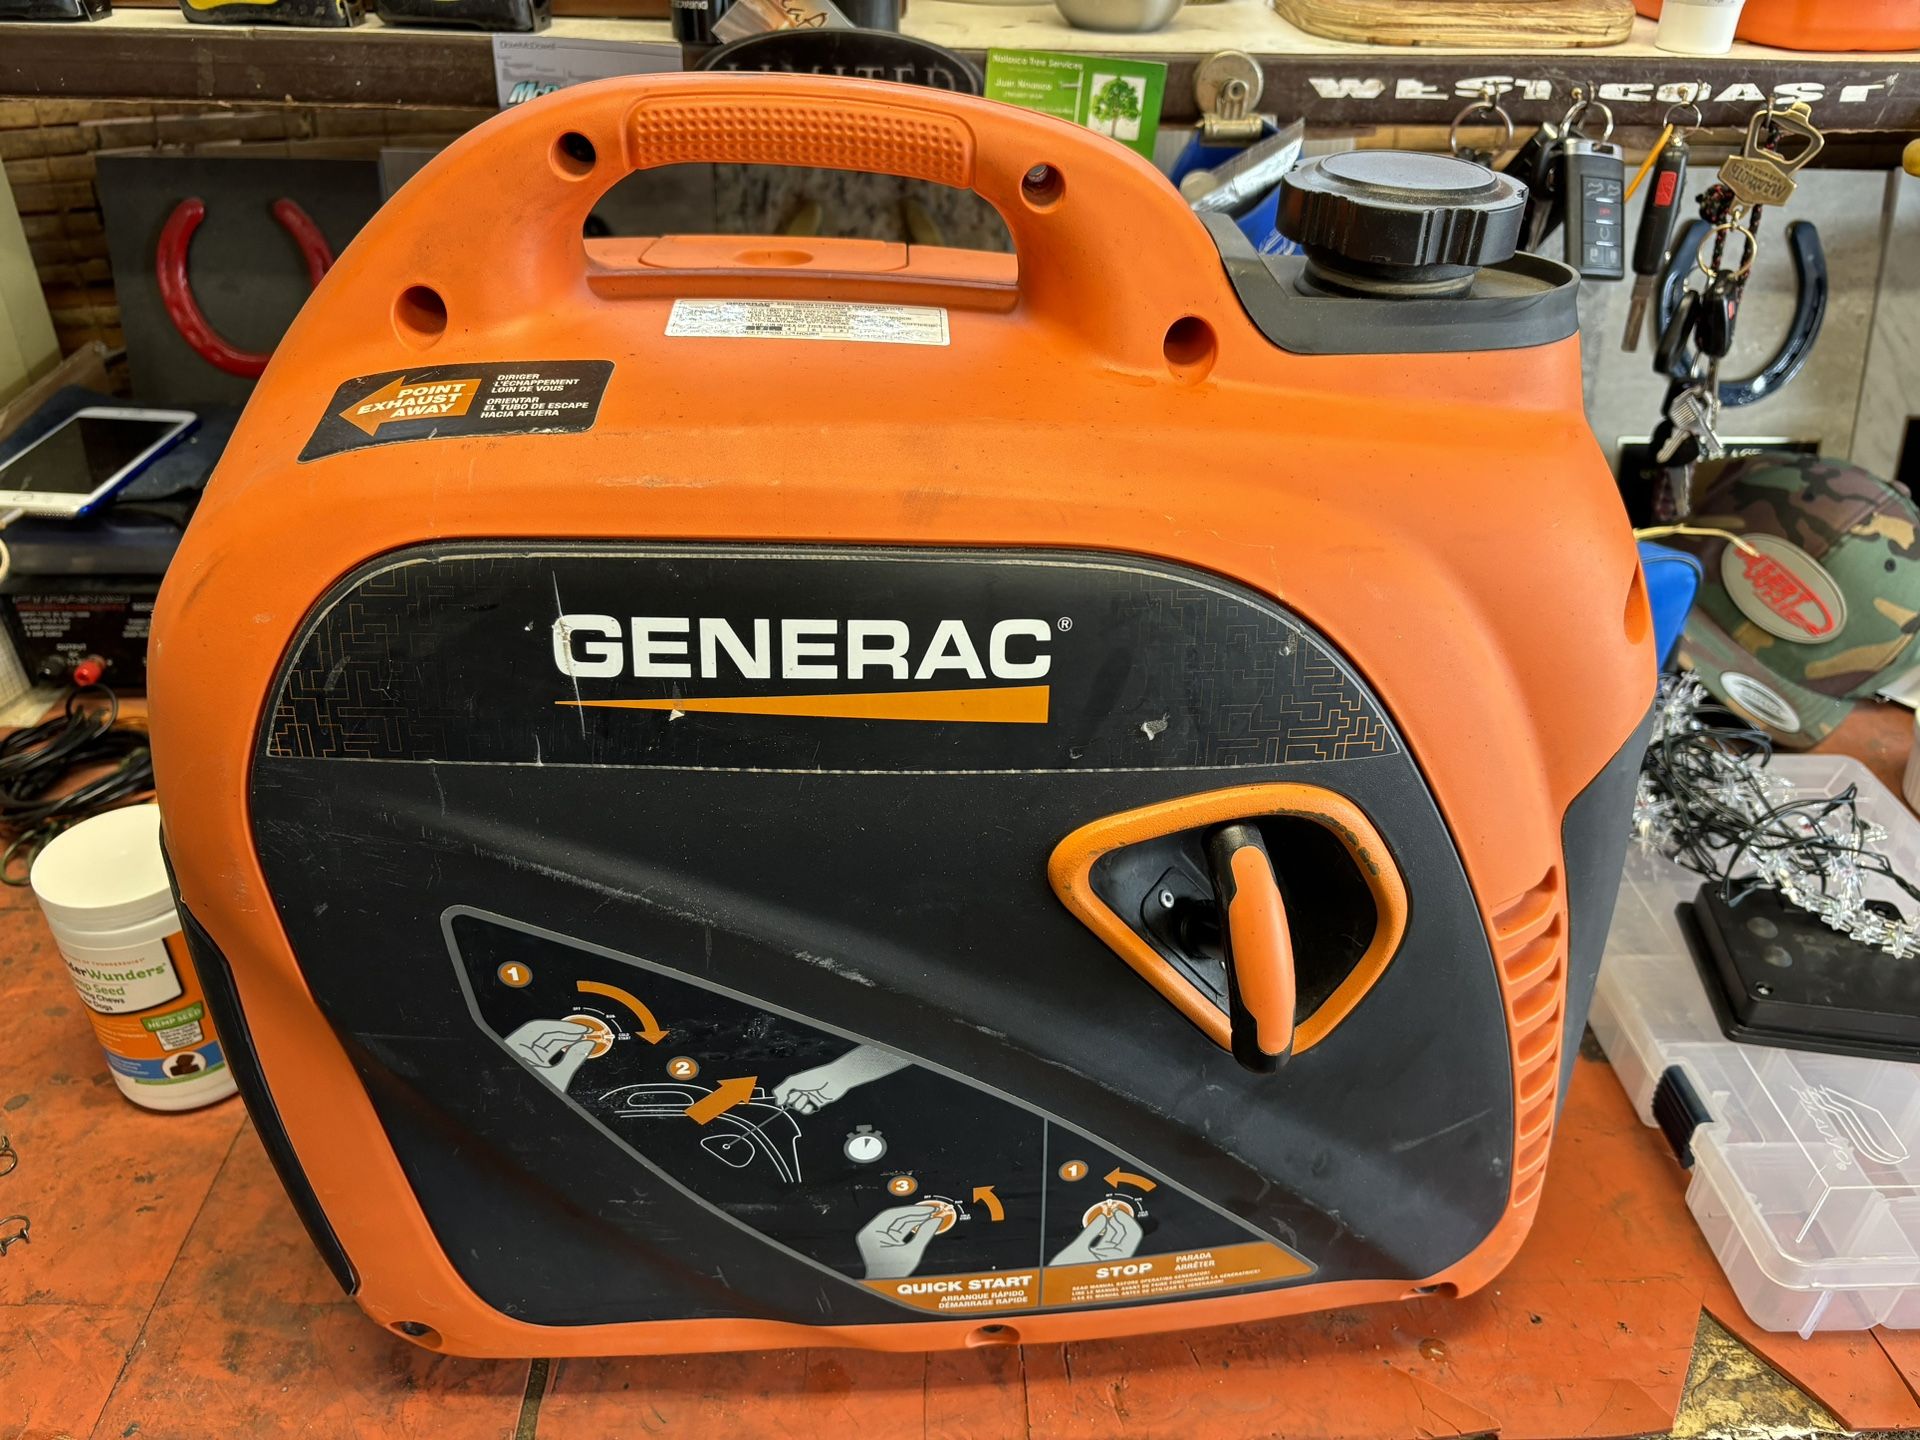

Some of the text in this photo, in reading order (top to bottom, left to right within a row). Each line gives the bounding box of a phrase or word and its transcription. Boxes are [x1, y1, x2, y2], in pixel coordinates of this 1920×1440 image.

[1308, 76, 1553, 100] WEST
[494, 379, 580, 387] L'ÉCHAPPEMENT
[497, 373, 540, 381] DIRIGER
[397, 384, 466, 398] POINT
[356, 393, 462, 415] EXHAUST
[487, 397, 540, 405] ORIENTAR
[500, 403, 529, 411] TUBO
[390, 403, 454, 418] AWAY
[516, 409, 559, 417] AFUERA
[95, 984, 126, 996] Seed
[1175, 1252, 1212, 1263] PARADA
[1095, 1263, 1153, 1279] STOP
[1175, 1260, 1216, 1271] ARRÊTER
[896, 1275, 1033, 1295] QUICK START
[940, 1289, 1025, 1302] ARRANQUE RÁPIDO
[938, 1296, 1028, 1309] DÉMARRAGE RAPIDE
